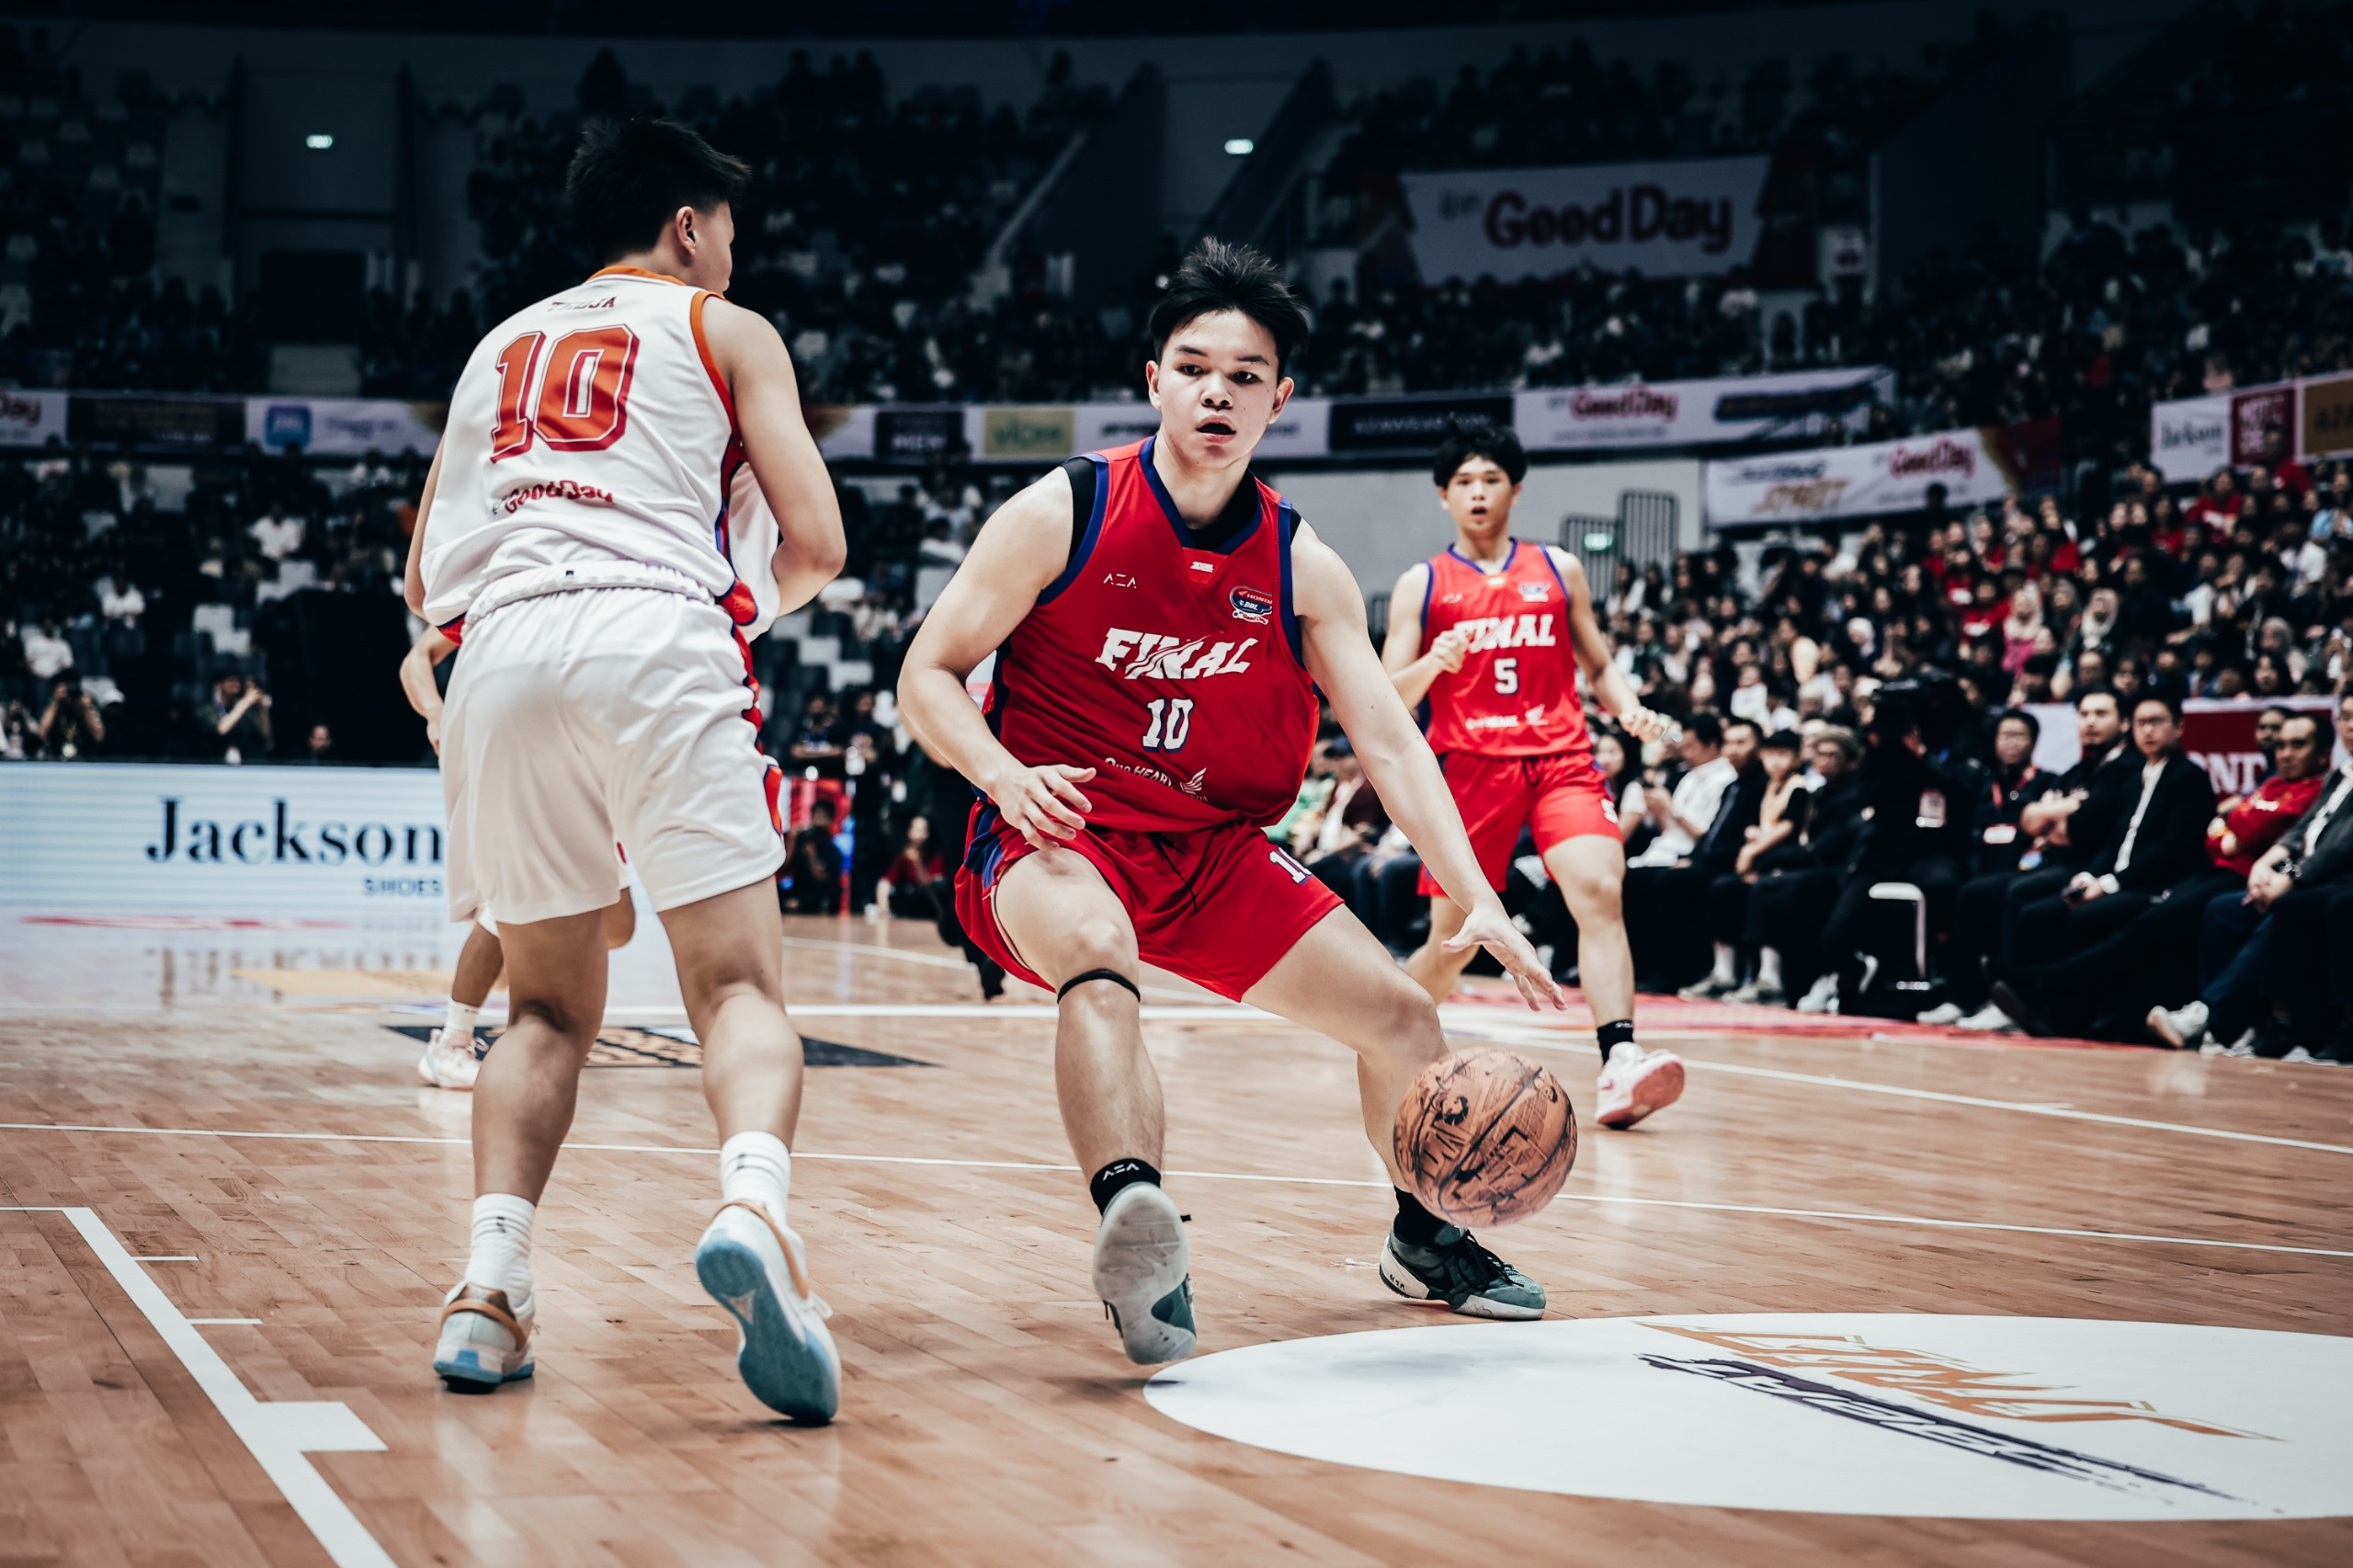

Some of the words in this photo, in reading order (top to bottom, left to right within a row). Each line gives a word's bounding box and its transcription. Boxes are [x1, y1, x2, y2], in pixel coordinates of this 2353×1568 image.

[490, 324, 640, 463] 10
[1095, 627, 1258, 680] FINAL
[1495, 658, 1517, 695] 5
[1142, 698, 1194, 751] 10
[144, 795, 444, 866] Jackson
[363, 876, 443, 897] SHOES
